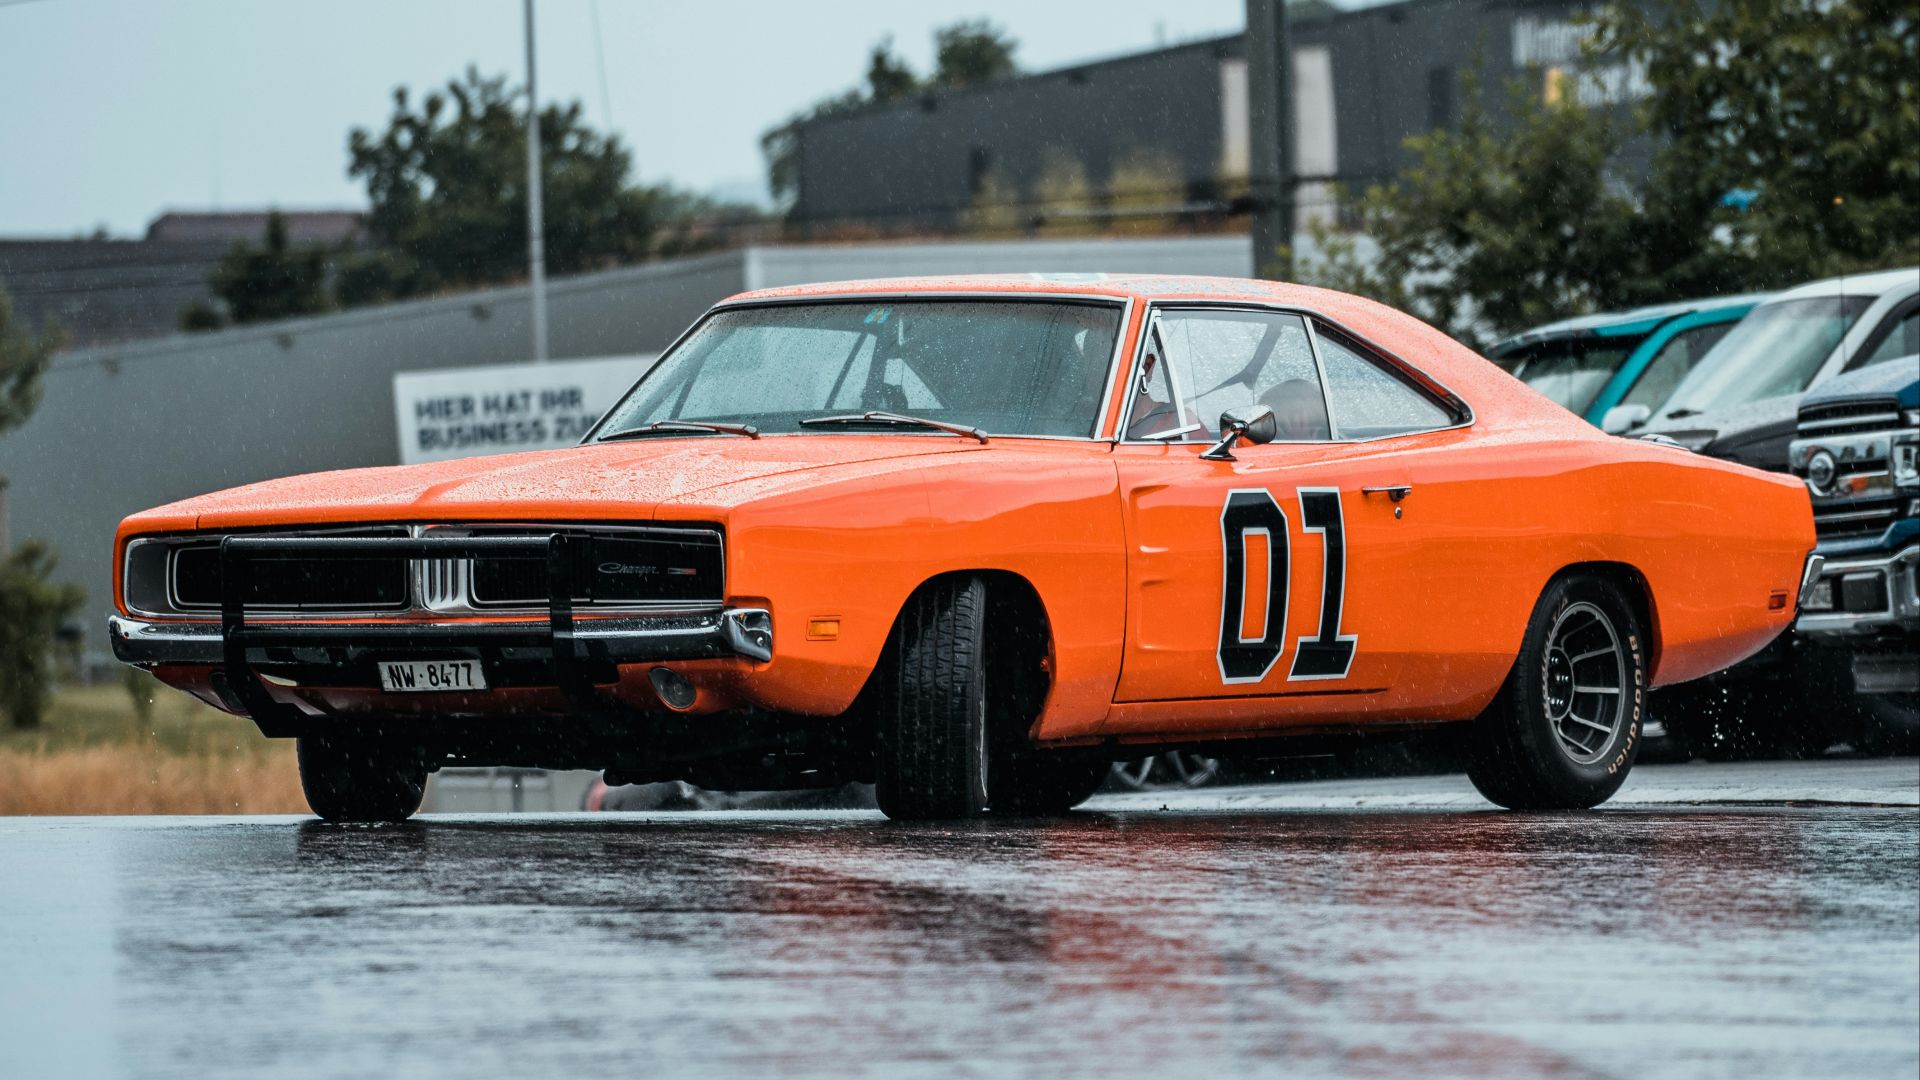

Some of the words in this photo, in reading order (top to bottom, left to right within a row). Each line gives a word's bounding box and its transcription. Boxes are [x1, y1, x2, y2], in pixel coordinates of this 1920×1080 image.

[416, 396, 475, 419] HIER
[482, 392, 531, 414] HAT
[541, 388, 583, 411] IHR
[418, 418, 547, 451] BUSINESS
[1216, 486, 1358, 685] 01
